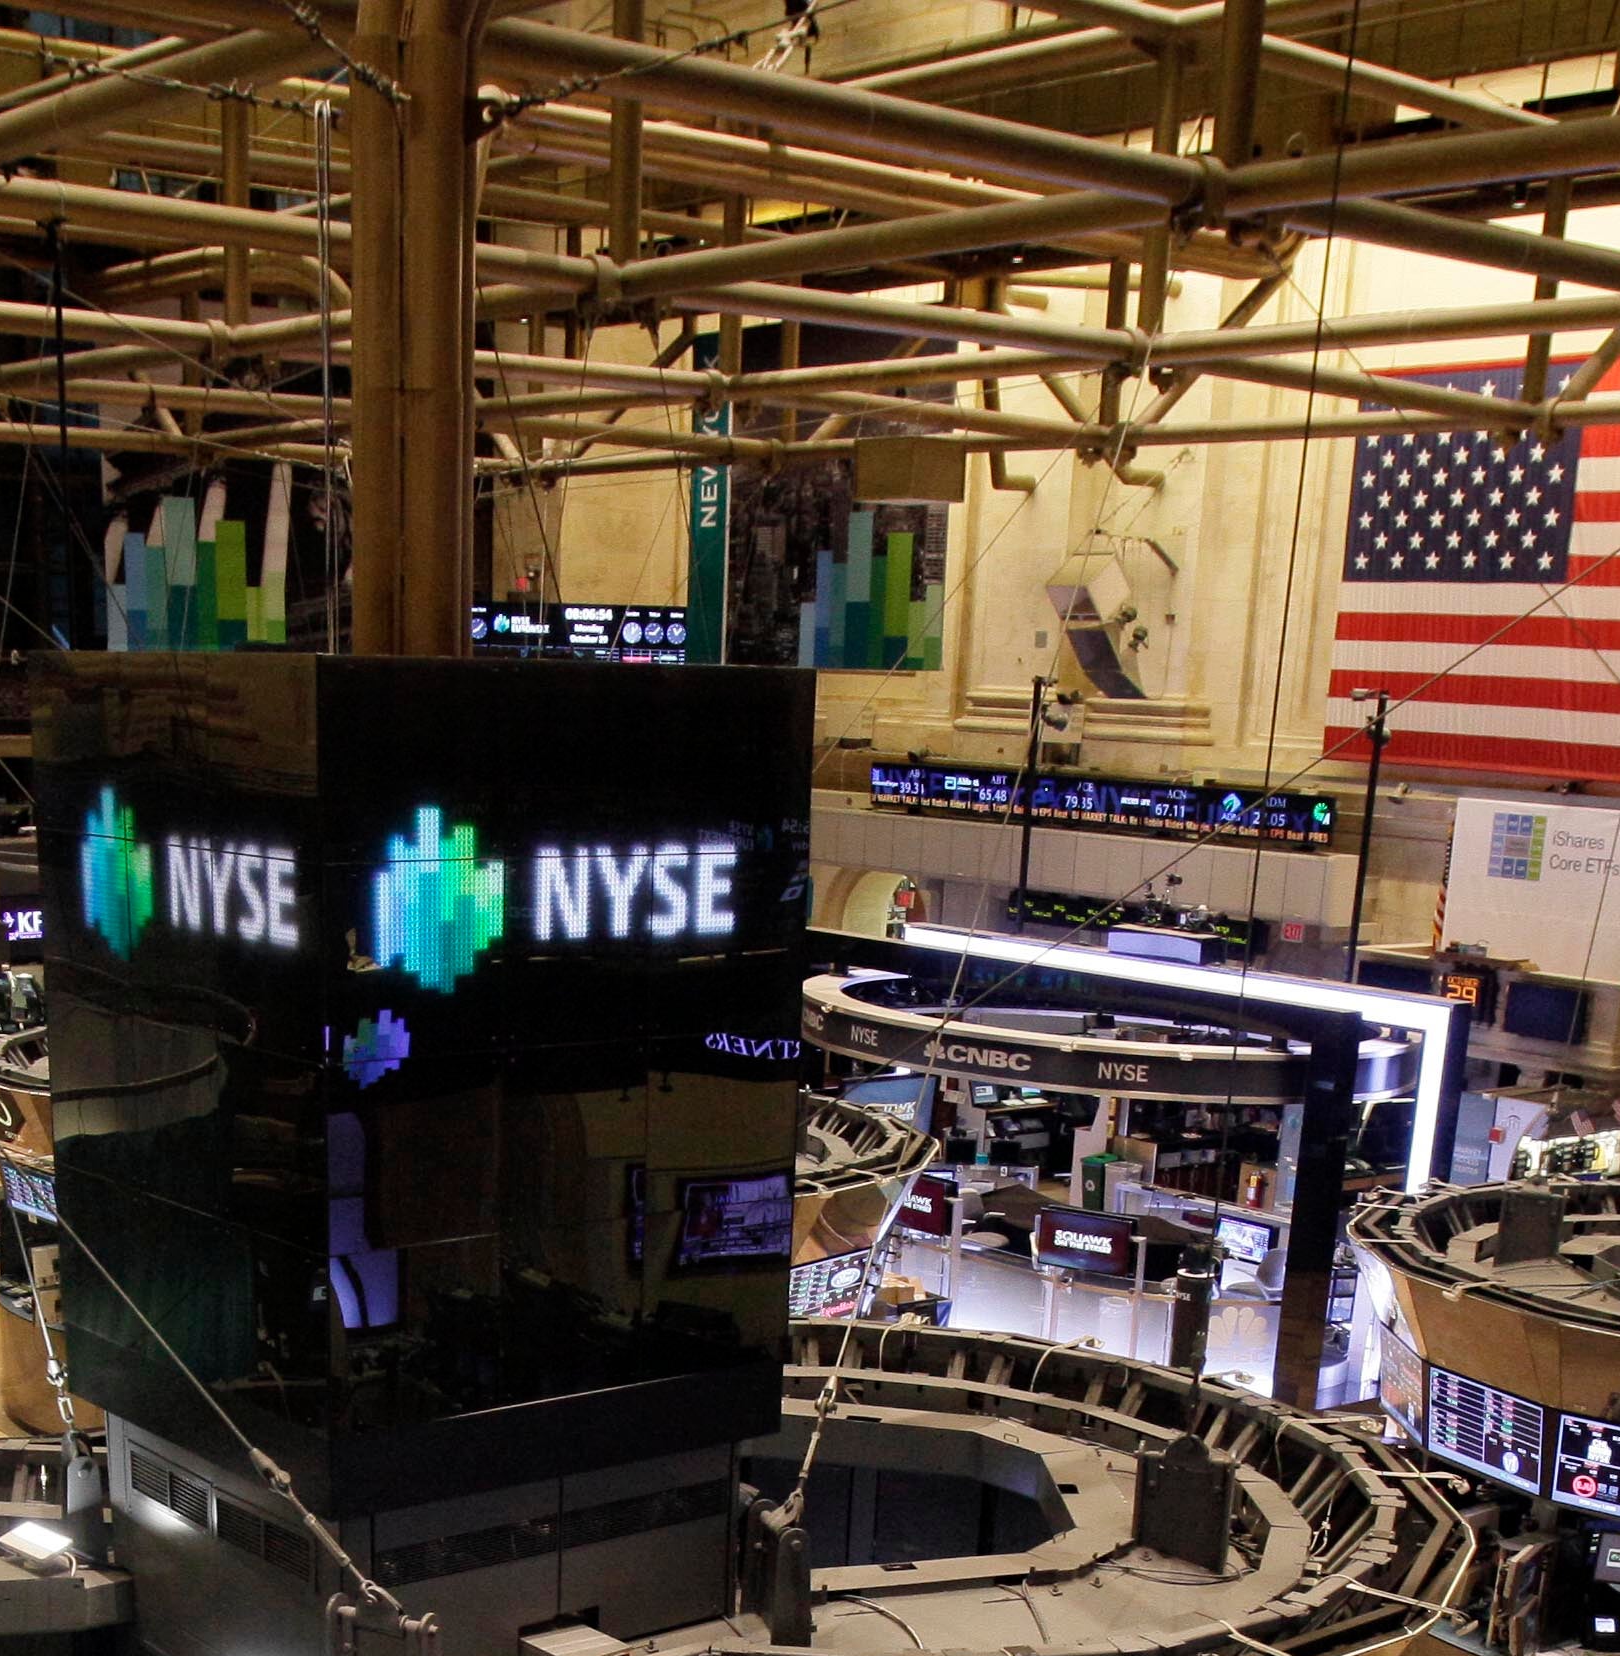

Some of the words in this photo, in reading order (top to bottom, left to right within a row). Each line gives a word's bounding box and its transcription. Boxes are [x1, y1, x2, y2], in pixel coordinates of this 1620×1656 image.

[979, 788, 1007, 802] 65.48
[1155, 803, 1185, 818] 67.11
[1552, 830, 1605, 850] iShares
[1549, 854, 1581, 872] Core
[1585, 858, 1620, 876] ETFs
[166, 833, 299, 949] NYSE
[533, 843, 738, 942] NYSE
[1446, 984, 1477, 1007] 29
[850, 1024, 878, 1047] NYSE
[944, 1044, 1032, 1072] CNBC
[1098, 1061, 1149, 1083] NYSE
[1054, 1229, 1113, 1247] SQUAWK
